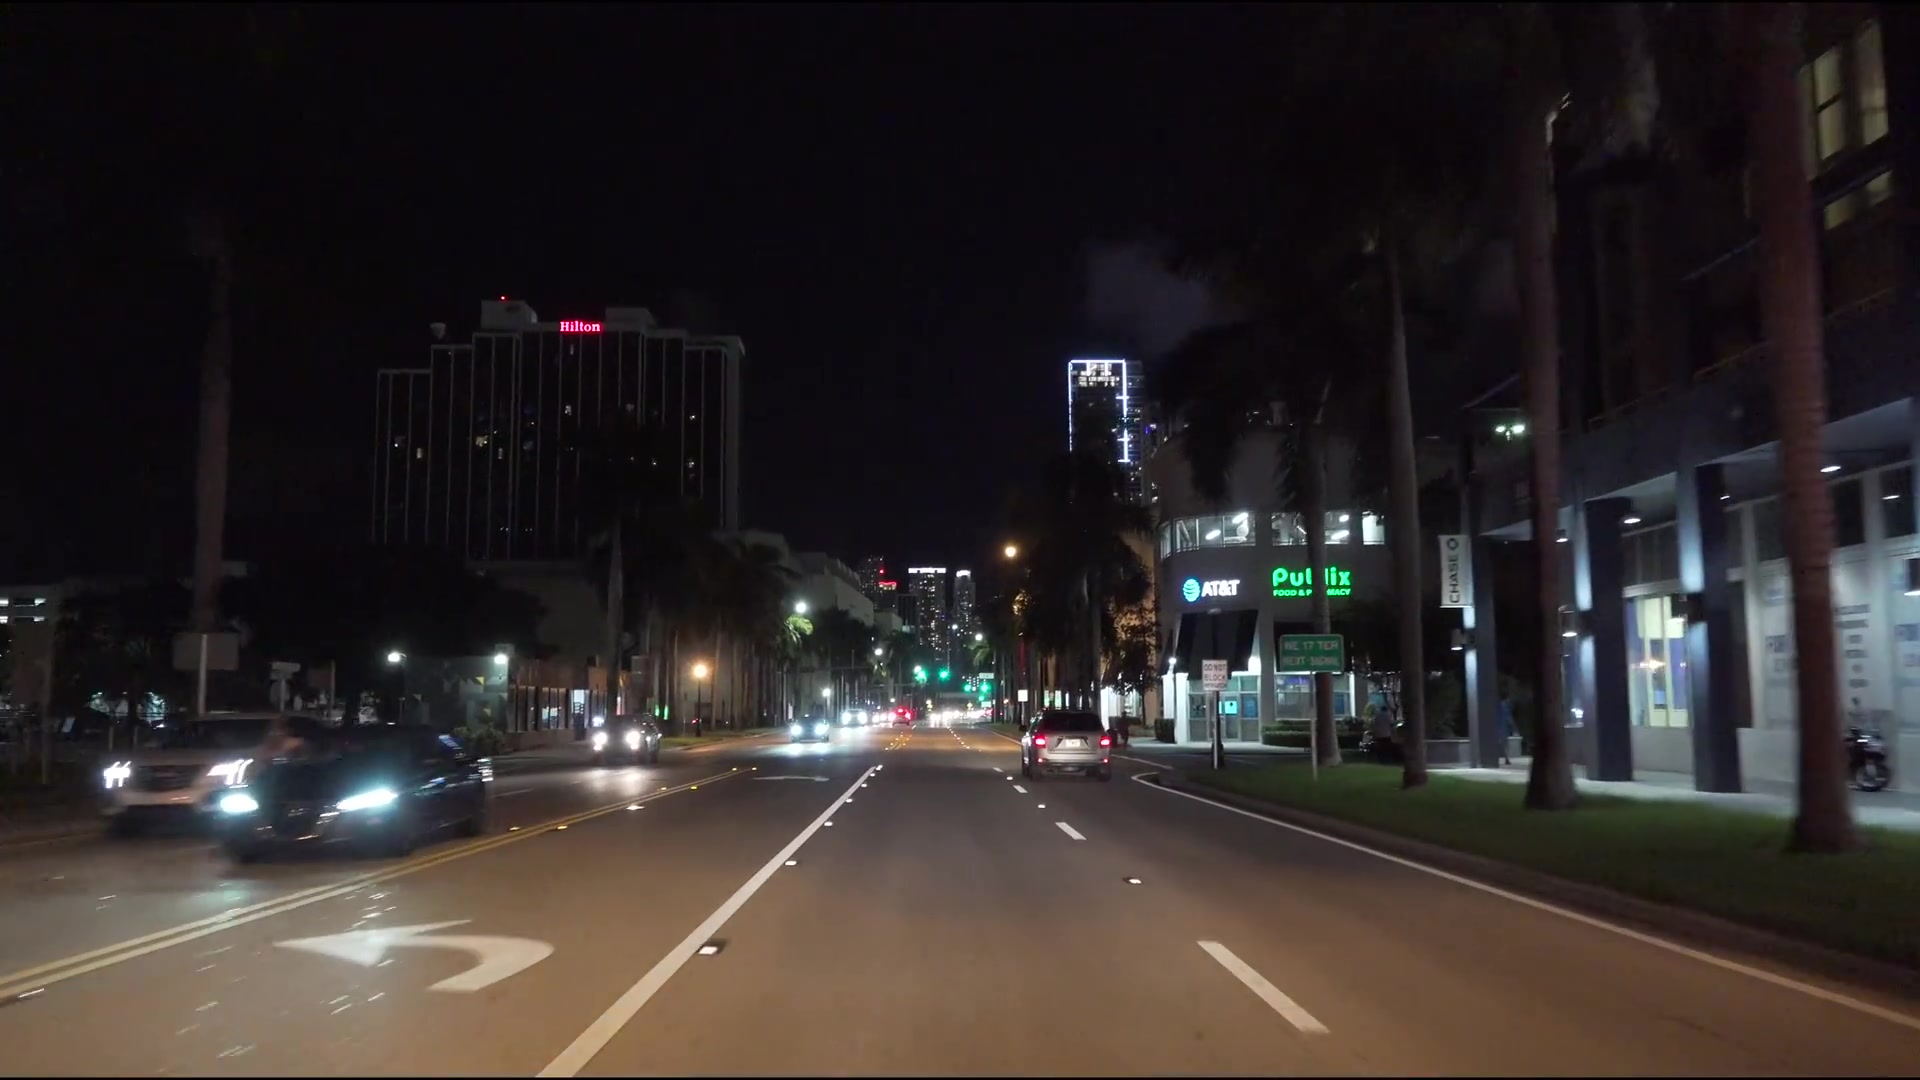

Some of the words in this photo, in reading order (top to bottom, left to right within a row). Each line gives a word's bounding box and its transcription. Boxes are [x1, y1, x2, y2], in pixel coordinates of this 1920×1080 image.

[559, 320, 601, 332] Hilton
[1448, 555, 1460, 603] CHASE
[1201, 579, 1241, 597] AT&T
[1273, 589, 1298, 597] FOOD
